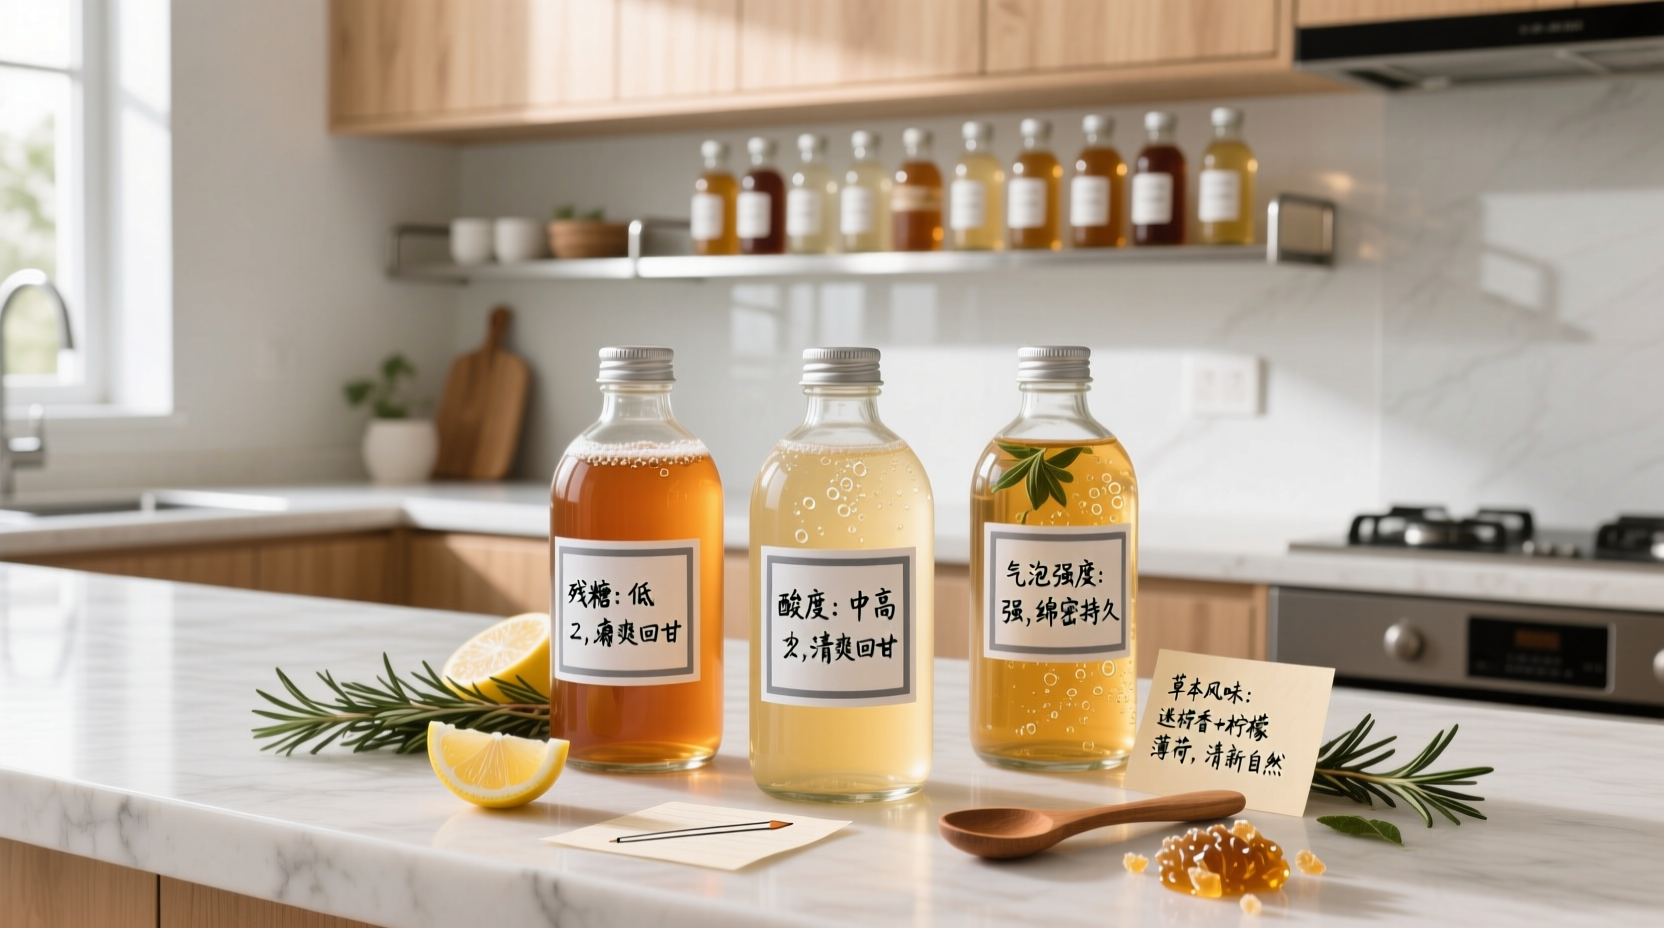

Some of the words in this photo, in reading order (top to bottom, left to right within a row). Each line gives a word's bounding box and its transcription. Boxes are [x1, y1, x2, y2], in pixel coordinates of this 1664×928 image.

[1006, 558, 1103, 588] 气泡强度：
[568, 579, 655, 609] 残糖：低
[778, 587, 896, 622] 酸度：中高
[1001, 596, 1120, 628] 强，绵密持久
[1167, 672, 1252, 705] 草本风味：
[1150, 733, 1286, 777] 薄荷，清新自然
